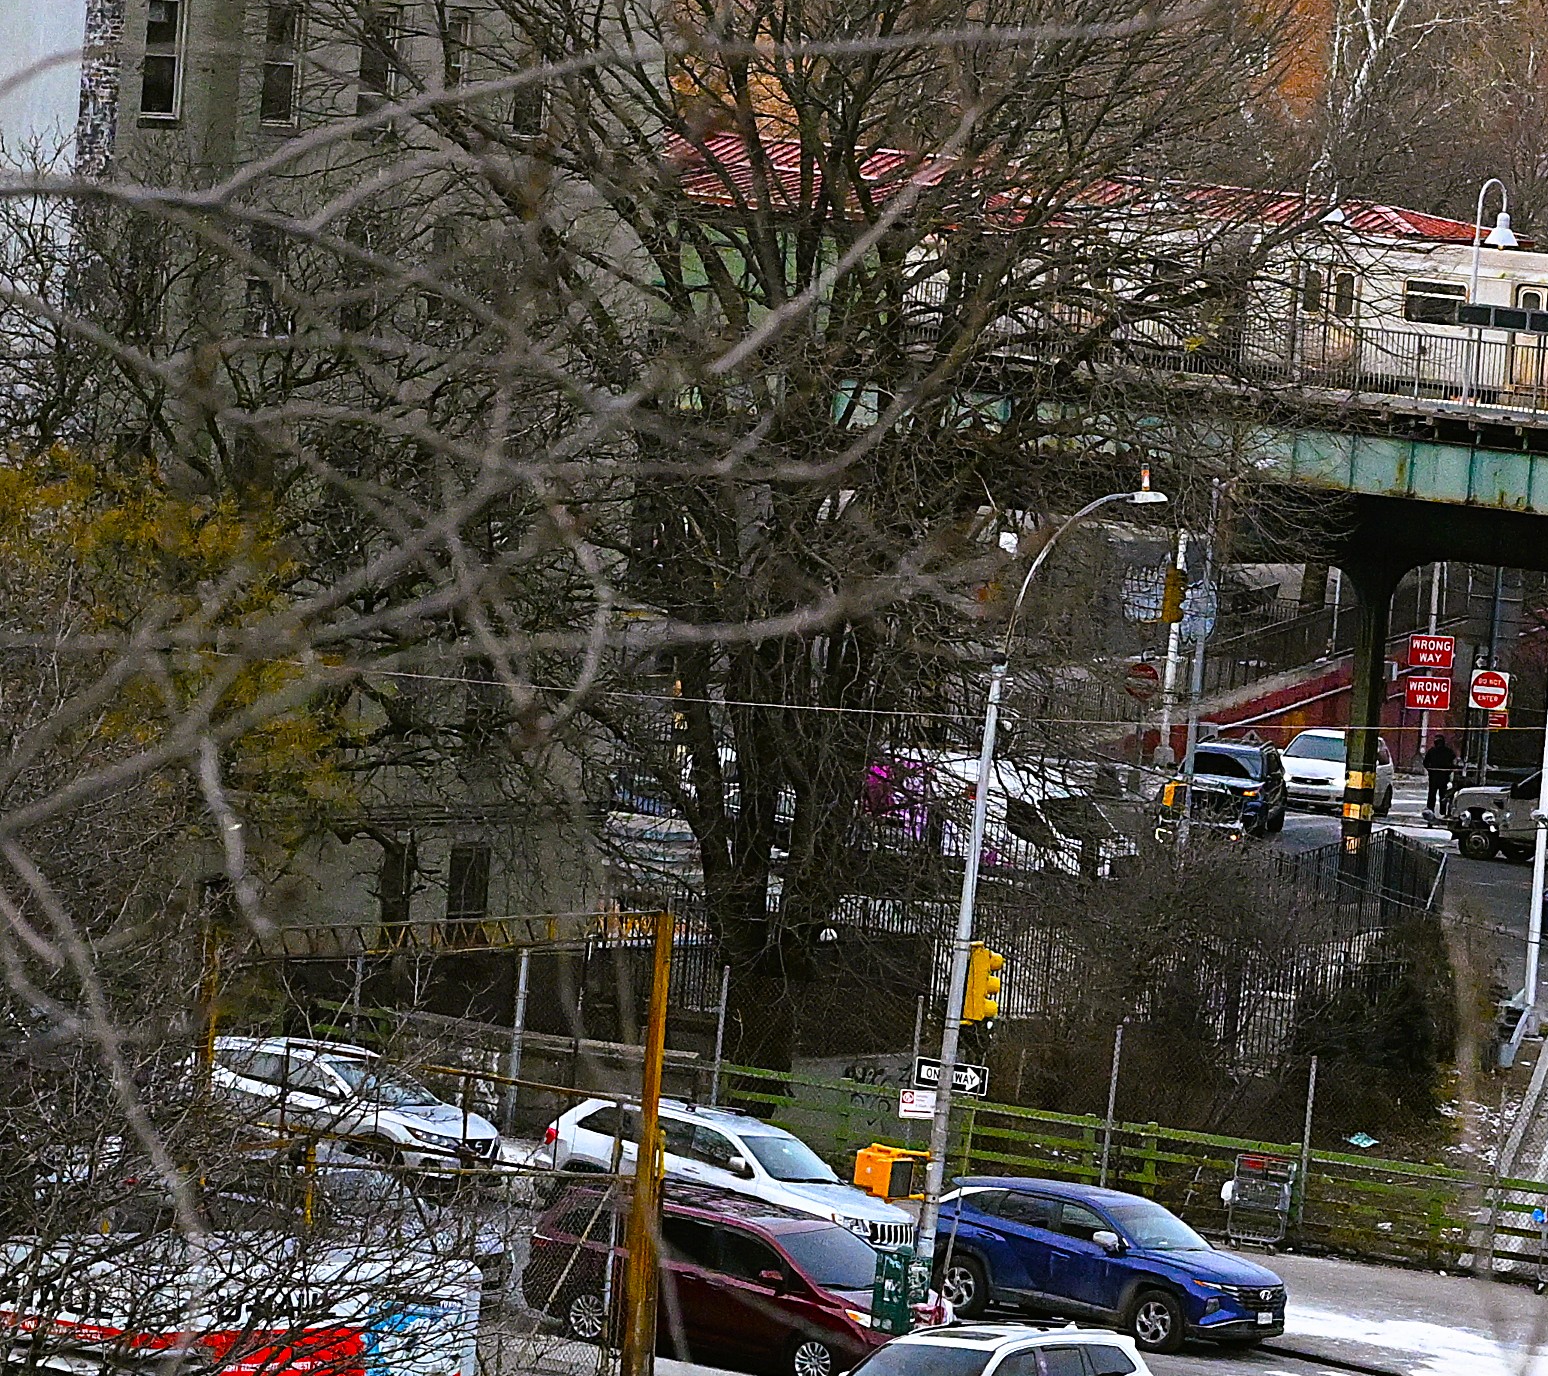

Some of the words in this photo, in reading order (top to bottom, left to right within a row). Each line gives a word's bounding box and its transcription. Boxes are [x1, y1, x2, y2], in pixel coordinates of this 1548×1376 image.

[1412, 639, 1452, 651] WRONG
[1420, 653, 1444, 662] WAY
[1409, 681, 1448, 693] WRONG
[1416, 694, 1440, 704] WAY
[955, 1073, 976, 1086] WAY
